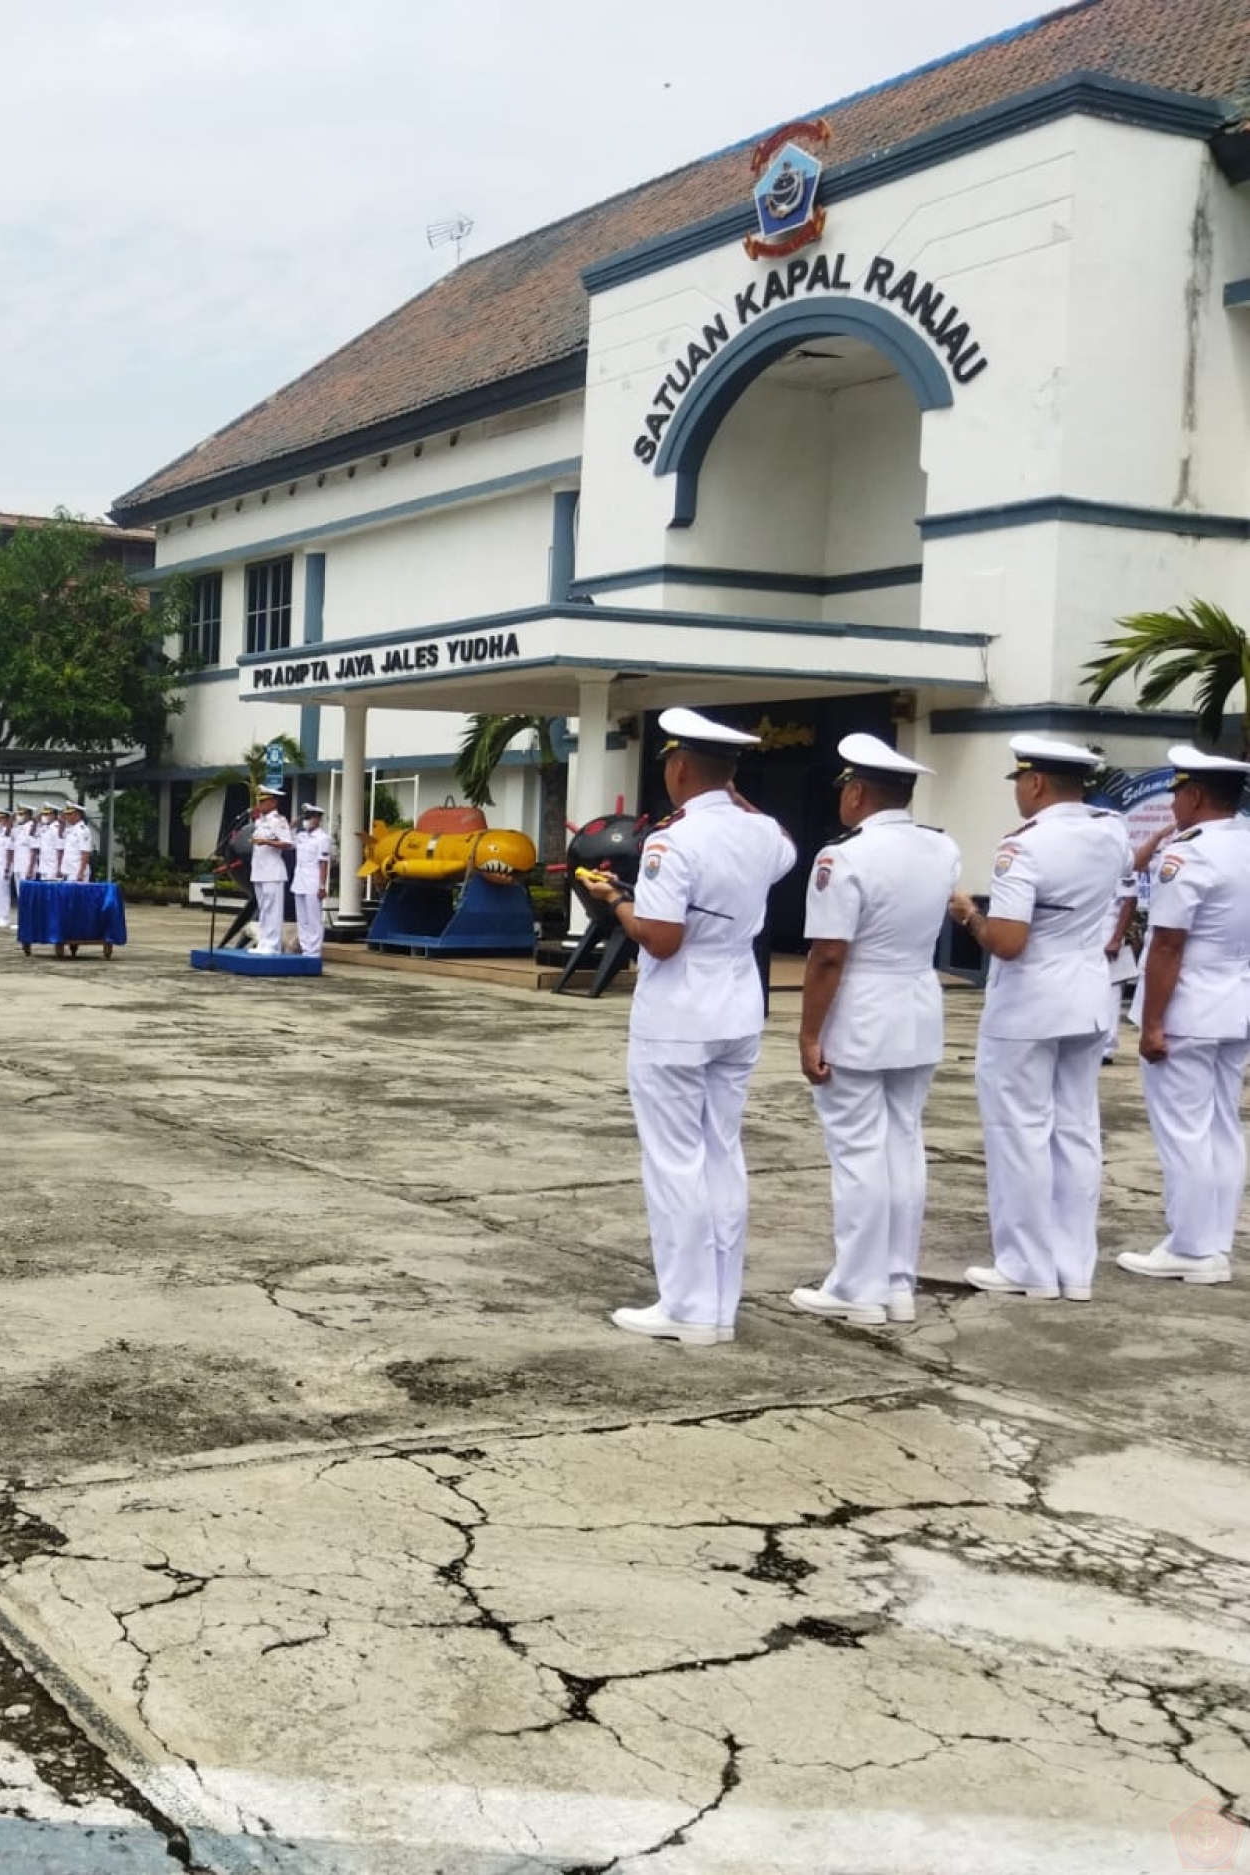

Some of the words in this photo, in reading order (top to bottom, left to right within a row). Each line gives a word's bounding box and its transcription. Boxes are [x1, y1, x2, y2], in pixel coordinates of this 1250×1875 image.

[634, 313, 729, 464] SATUAN
[735, 254, 851, 324] KAPAL
[864, 256, 988, 384] RANJAU
[253, 661, 329, 688] PRADIPTA
[335, 654, 375, 679] JAYA
[381, 644, 439, 673] JALES
[445, 633, 520, 663] YUDHA
